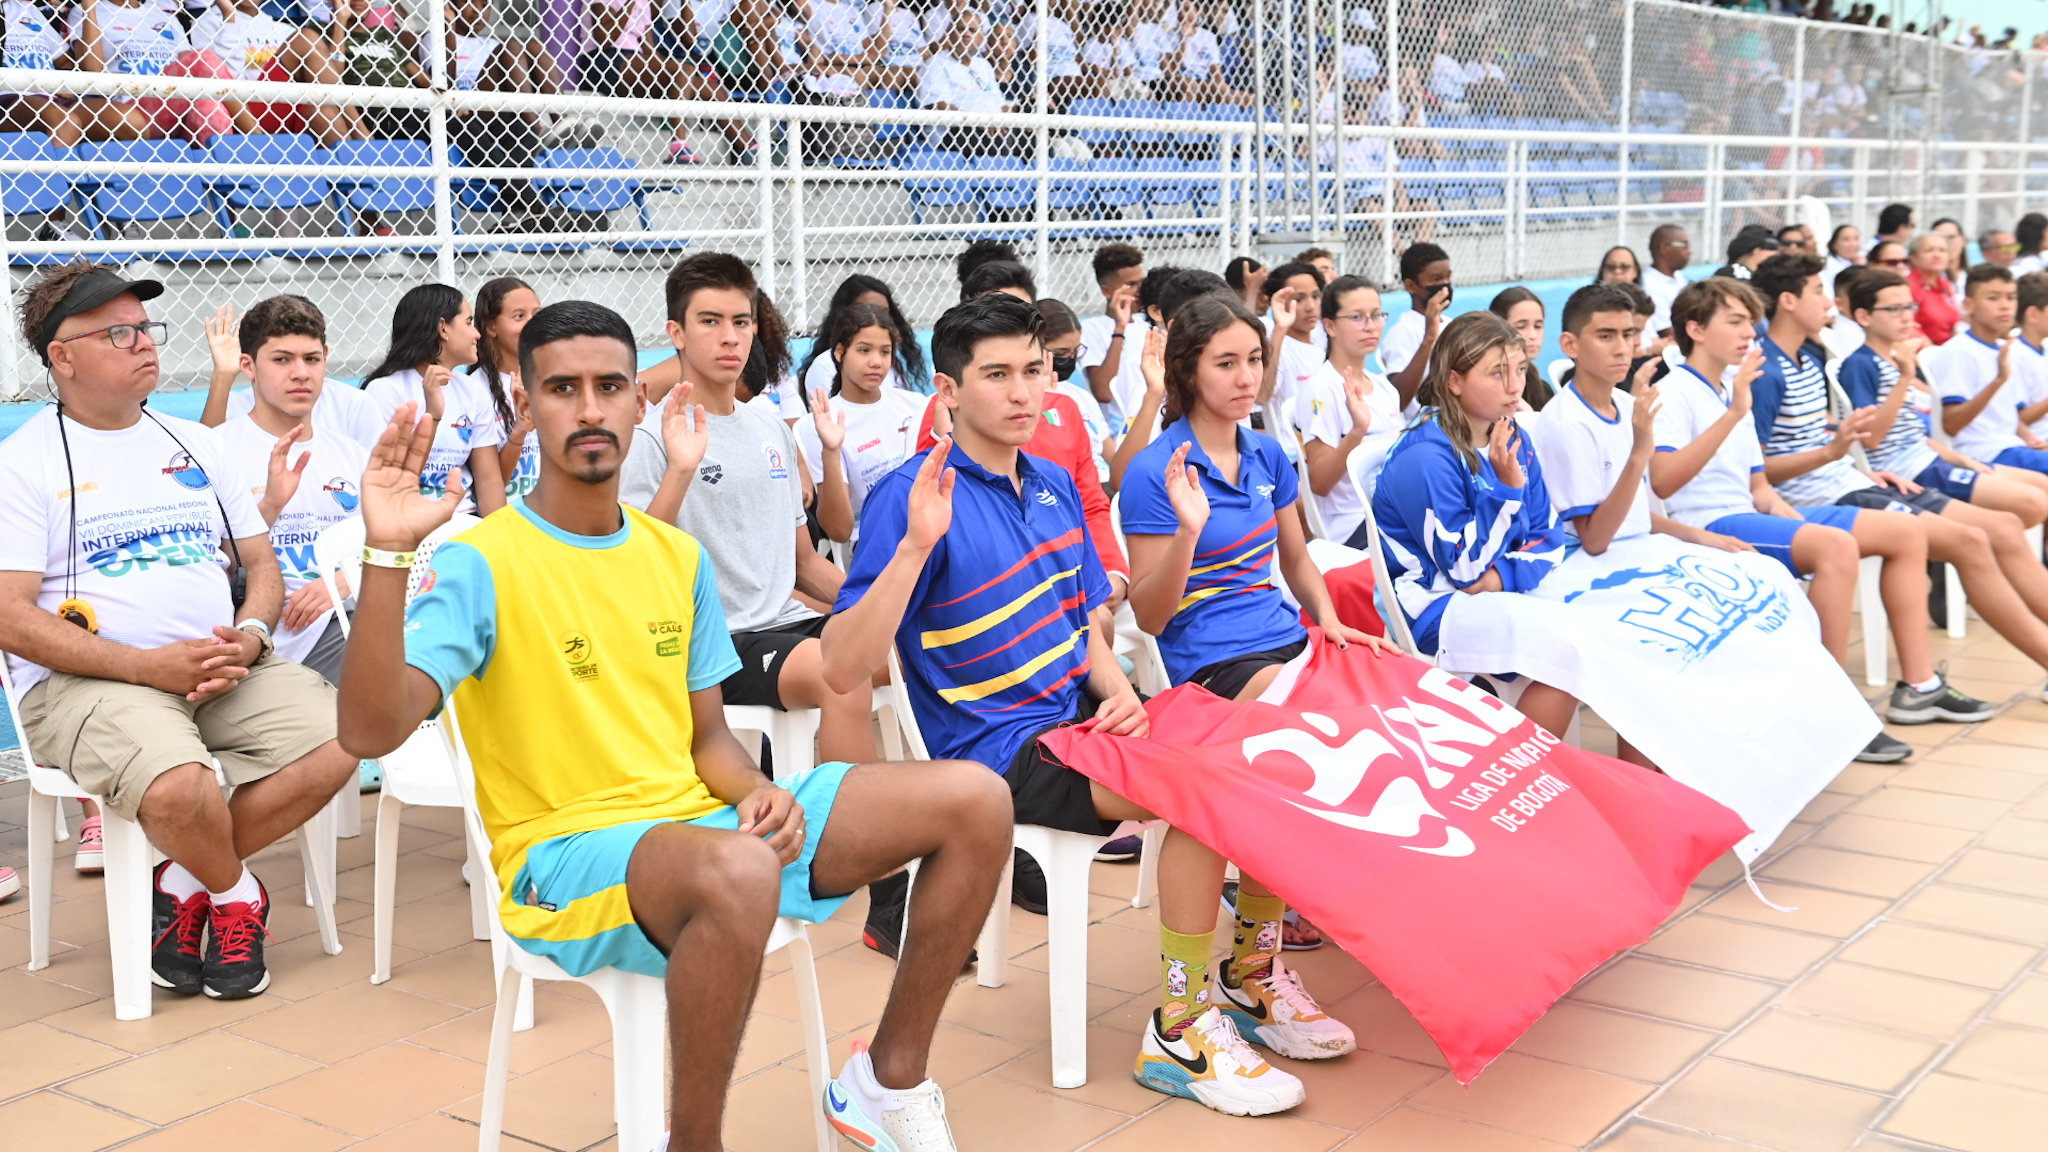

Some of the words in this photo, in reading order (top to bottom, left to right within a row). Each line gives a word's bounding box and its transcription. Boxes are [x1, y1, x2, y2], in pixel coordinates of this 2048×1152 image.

[700, 464, 721, 475] arena
[77, 510, 134, 526] CAMPEONATO
[136, 504, 177, 515] NACIONAL
[179, 501, 208, 509] FEDONA
[79, 529, 94, 539] VII
[97, 516, 164, 535] DOMINICAN
[166, 511, 212, 522] REPUBLIC
[82, 521, 212, 552] INTERNATIONAL
[98, 543, 214, 577] OPEN
[1450, 776, 1499, 811] LIGA
[1488, 762, 1517, 787] DE
[1490, 806, 1526, 833] DE
[1508, 770, 1570, 819] BOGOTÁ
